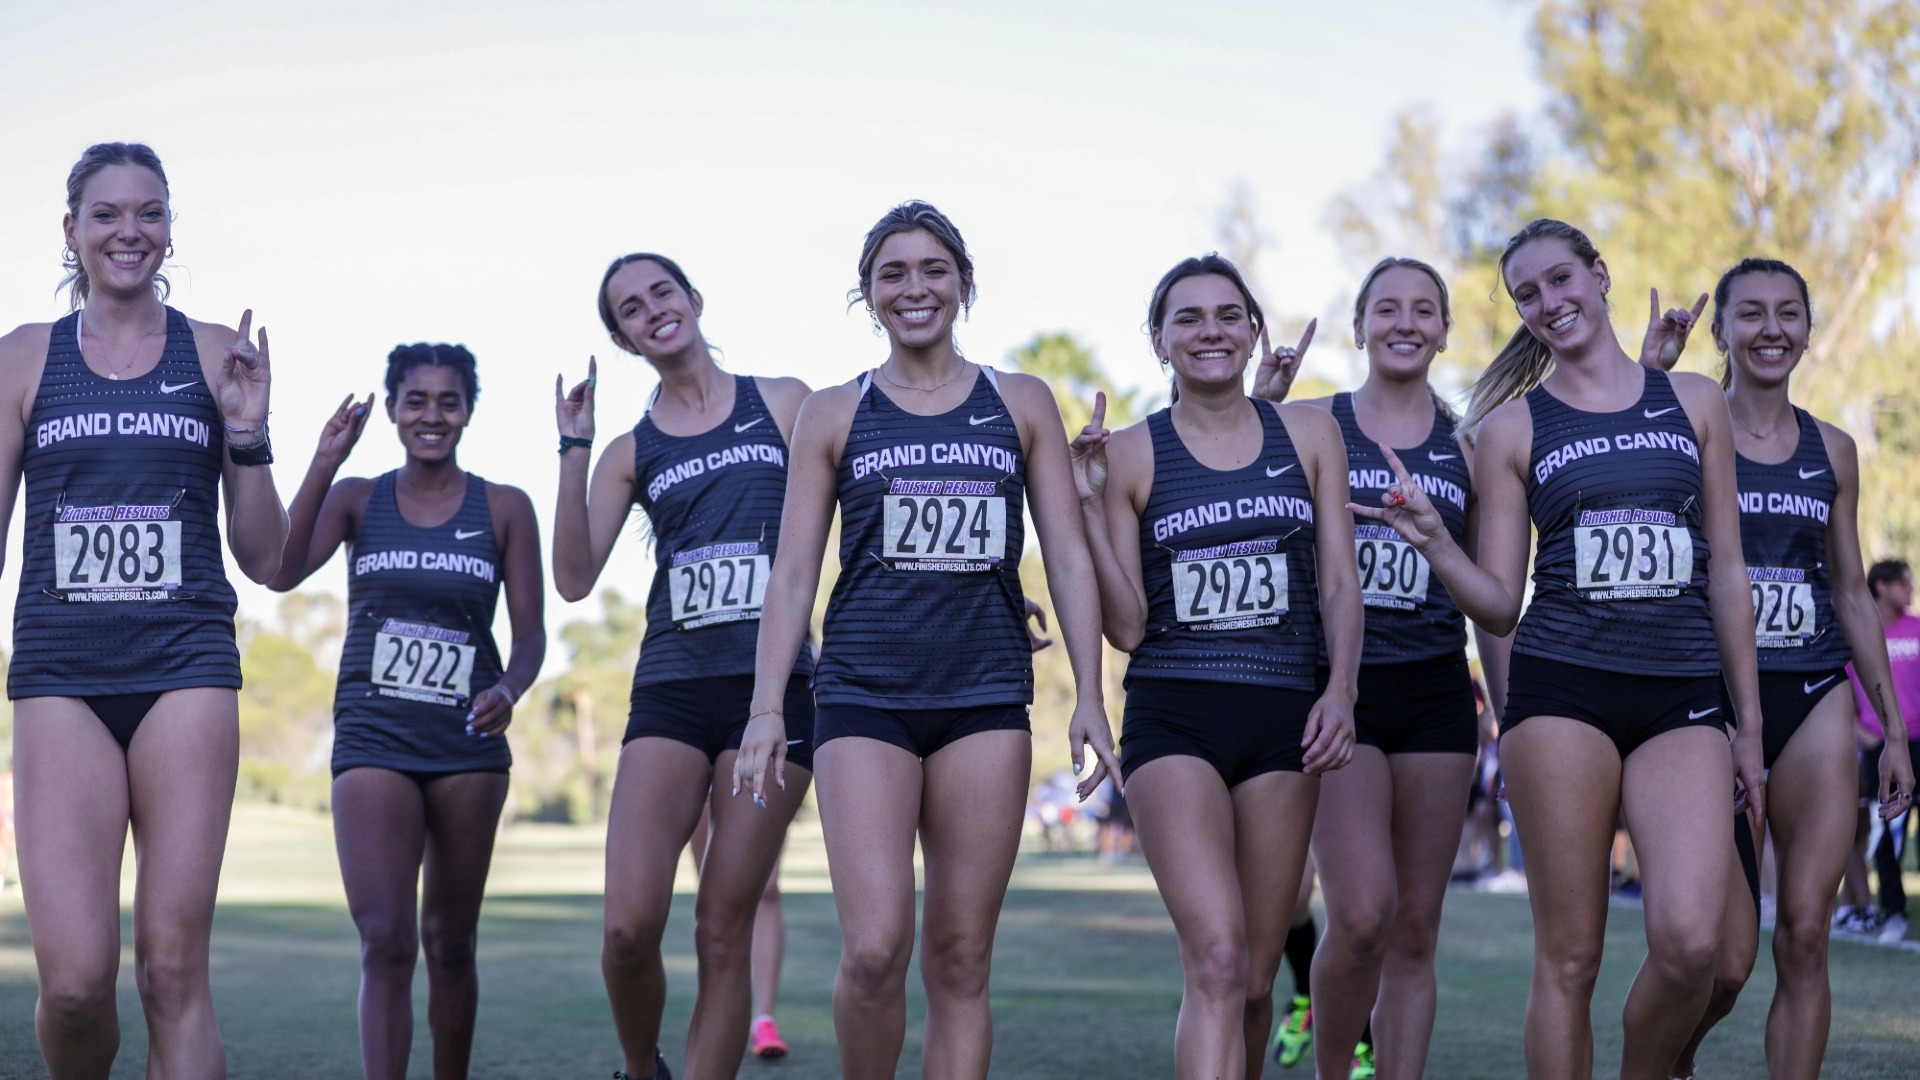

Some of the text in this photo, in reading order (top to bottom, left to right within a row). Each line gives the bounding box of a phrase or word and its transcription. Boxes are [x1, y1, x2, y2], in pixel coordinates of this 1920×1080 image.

[37, 412, 210, 449] GRAND CANYON
[647, 444, 784, 503] GRAND CANYON
[852, 443, 1017, 481] GRAND CANYON
[1535, 431, 1700, 485] GRAND CANYON
[889, 478, 996, 495] FINISHED RESULTS
[1348, 469, 1466, 511] AND ANYON
[60, 505, 170, 522] FINISHED RESULTS
[896, 497, 991, 555] 2924
[1154, 495, 1313, 542] GRAND CANYON
[1580, 508, 1676, 526] FINISHED RESULTS
[69, 523, 165, 584] 2983
[356, 551, 494, 583] GRAND CANYON
[673, 542, 759, 567] FINISHED RESULTS
[894, 561, 992, 572] WWW.FINISHEDRESULTS.COM
[1177, 539, 1278, 562] FINISHED RESULTS
[1358, 541, 1418, 594] 930
[1590, 525, 1674, 583] 2931
[681, 558, 756, 614] 2927
[1187, 556, 1276, 617] 2923
[1764, 567, 1805, 582] RESULTS
[67, 590, 169, 602] WWW.FINISHEDRESULTS.COM
[1589, 588, 1680, 600] WWW.FINISHEDRESULTS.COM
[1752, 583, 1804, 632] 926
[1189, 616, 1280, 632] WWW.FINISHEDRESULTS.COM
[382, 636, 461, 691] 2922
